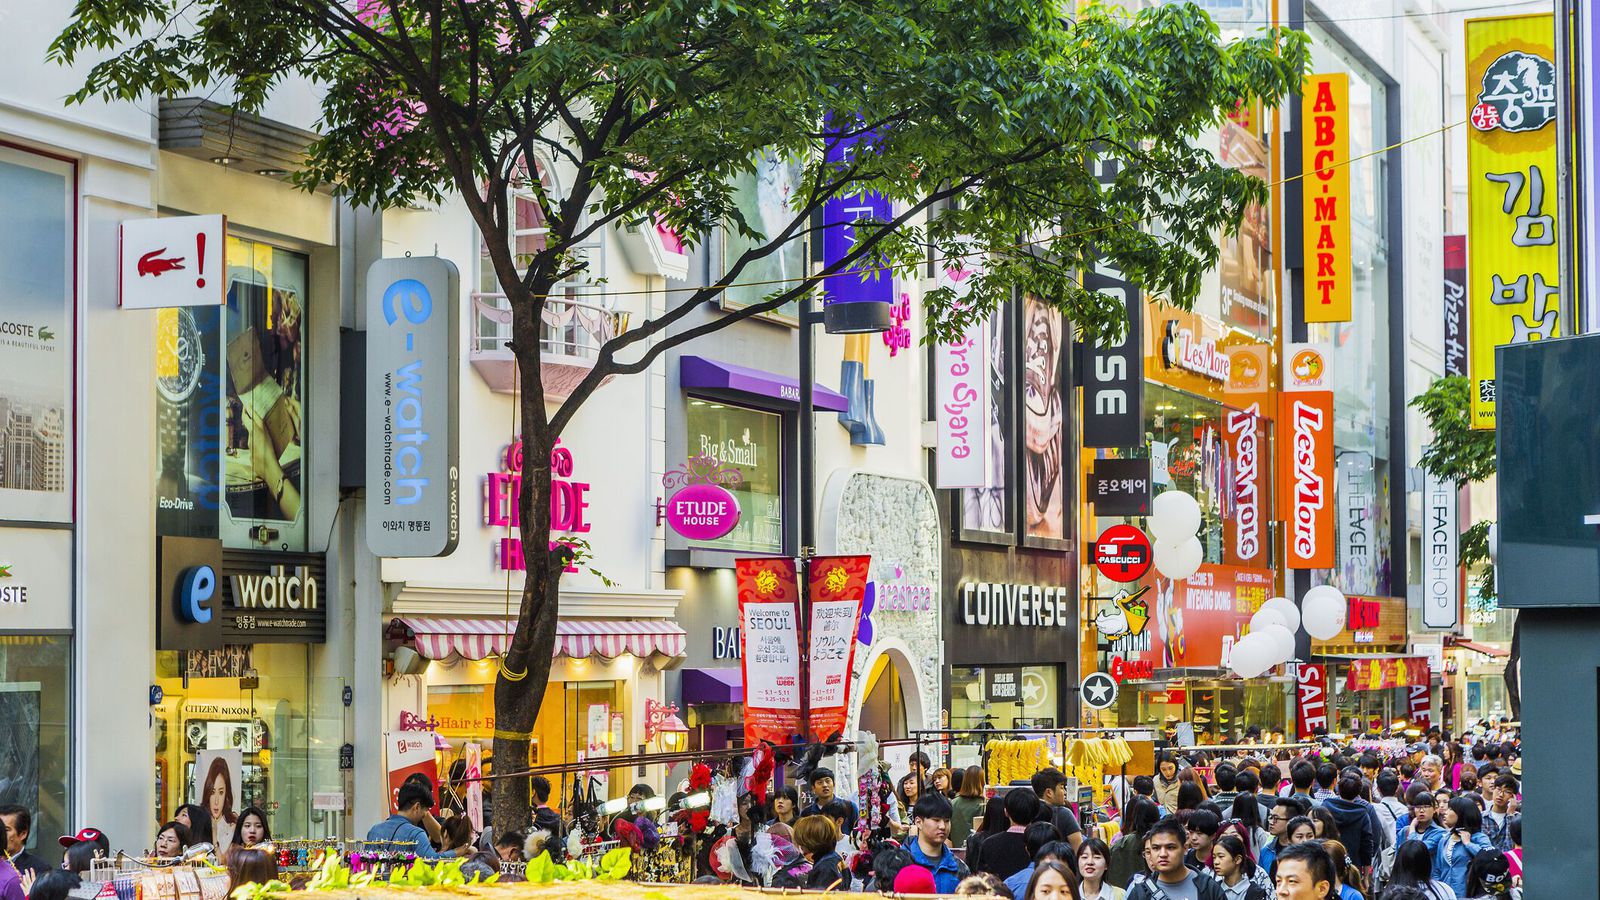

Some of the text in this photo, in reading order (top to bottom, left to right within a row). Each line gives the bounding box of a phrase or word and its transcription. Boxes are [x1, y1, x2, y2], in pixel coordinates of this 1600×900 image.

[1313, 82, 1337, 305] ABC-MART
[1444, 279, 1464, 337] Pizza
[0, 321, 34, 338] COSTE
[1183, 334, 1231, 377] LesMore
[382, 278, 433, 506] e-watch
[944, 382, 978, 460] Shara
[384, 372, 392, 506] www.e-watchtrade.com
[700, 434, 757, 467] Big & Small
[1098, 479, 1147, 495] 준오헤어
[1296, 403, 1321, 557] LesMore
[159, 496, 194, 510] Eco-Drive
[450, 466, 458, 541] e-watch
[676, 501, 727, 516] ETUDE
[382, 520, 431, 532] 이와치 명동점
[683, 516, 719, 526] HOUSE
[1099, 556, 1141, 564] PASCUCCI
[1207, 573, 1214, 586] TO
[184, 565, 318, 624] e watch
[964, 582, 1067, 627] CONVERSE
[1187, 587, 1214, 611] MYEONG
[1214, 590, 1231, 611] DONG
[749, 608, 790, 617] Welcome to
[750, 617, 792, 631] SEOUL
[713, 627, 742, 660] BA
[812, 648, 846, 661] ようこそ
[185, 705, 250, 715] CITIZEN NIXON
[1298, 666, 1327, 733] SALE
[1409, 685, 1431, 723] ALE
[440, 717, 471, 729] Hair
[341, 755, 354, 767] 20-1
